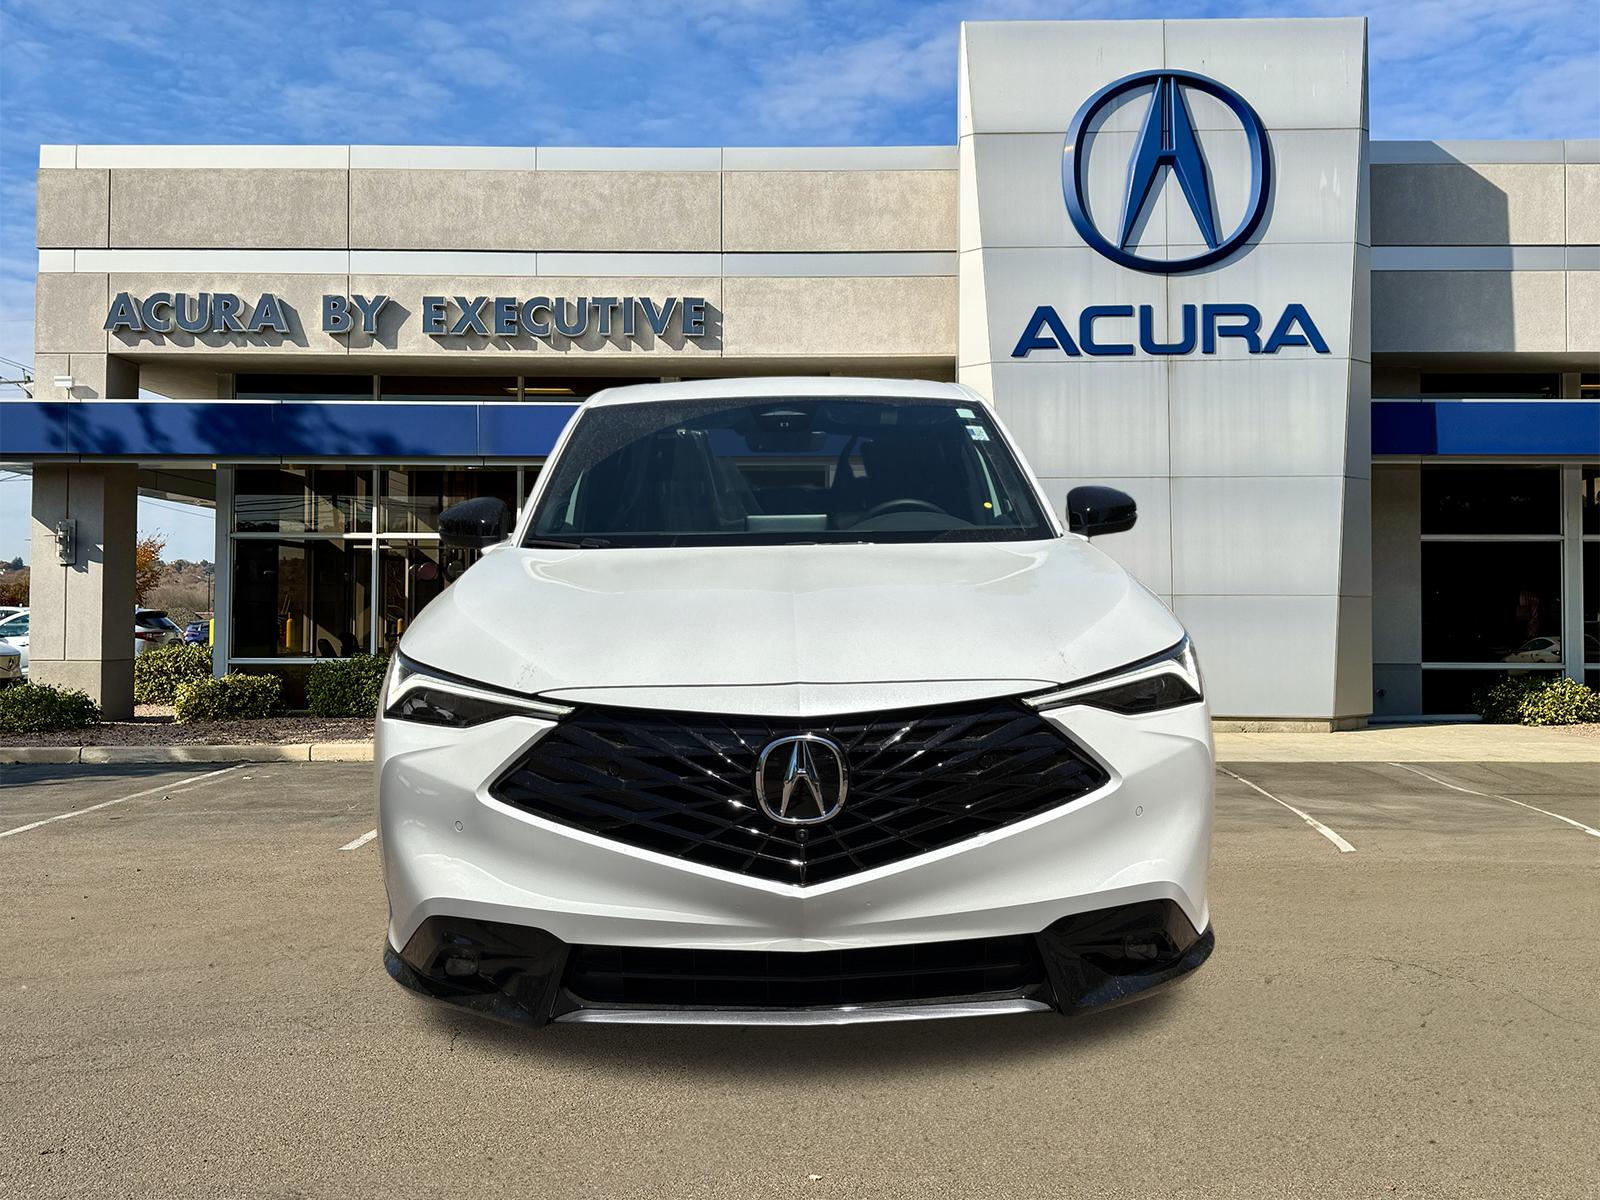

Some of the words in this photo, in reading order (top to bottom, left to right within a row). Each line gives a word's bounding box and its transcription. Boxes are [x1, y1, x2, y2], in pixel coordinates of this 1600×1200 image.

[104, 292, 291, 334] ACURA
[322, 294, 391, 335] BY
[423, 296, 708, 337] EXECUTIVE
[1011, 304, 1332, 357] ACURA
